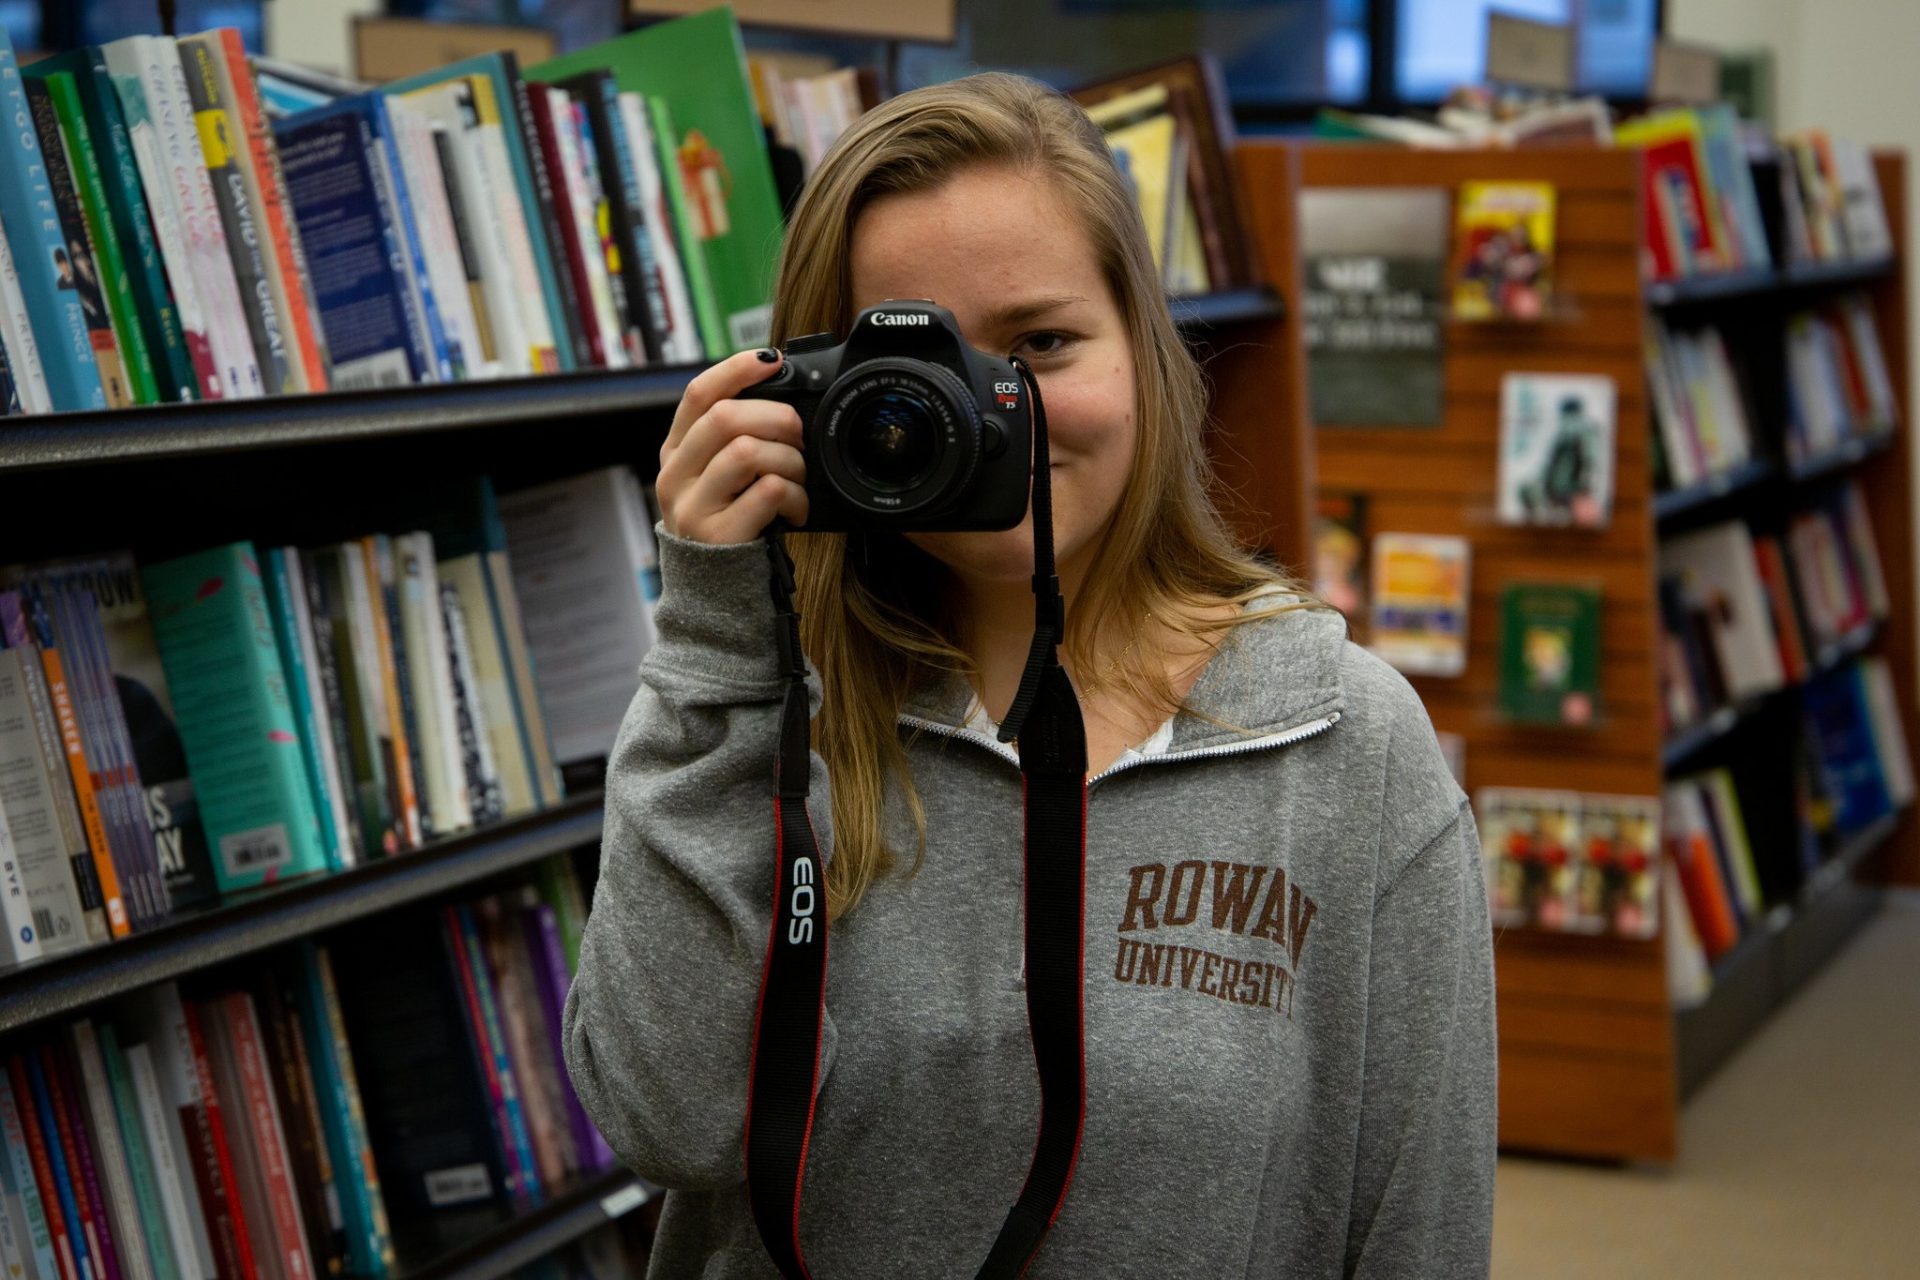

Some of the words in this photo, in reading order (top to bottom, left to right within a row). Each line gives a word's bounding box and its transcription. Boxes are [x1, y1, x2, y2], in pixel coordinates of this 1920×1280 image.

[28, 163, 57, 231] LIFE
[228, 174, 259, 246] DAVID
[254, 278, 286, 359] GREAT
[64, 301, 89, 363] PRINCE
[870, 312, 929, 326] Canon
[828, 409, 842, 436] CANON
[840, 388, 858, 408] ZOOM
[859, 378, 878, 391] LENS
[994, 382, 1019, 394] EOS
[1005, 401, 1016, 409] T5
[51, 680, 81, 756] SHAKEN
[3, 861, 21, 898] BYE
[788, 856, 815, 945] EOS
[1118, 860, 1318, 972] ROWAN
[2, 1083, 25, 1147] LOVE
[22, 1184, 50, 1249] LASTS
